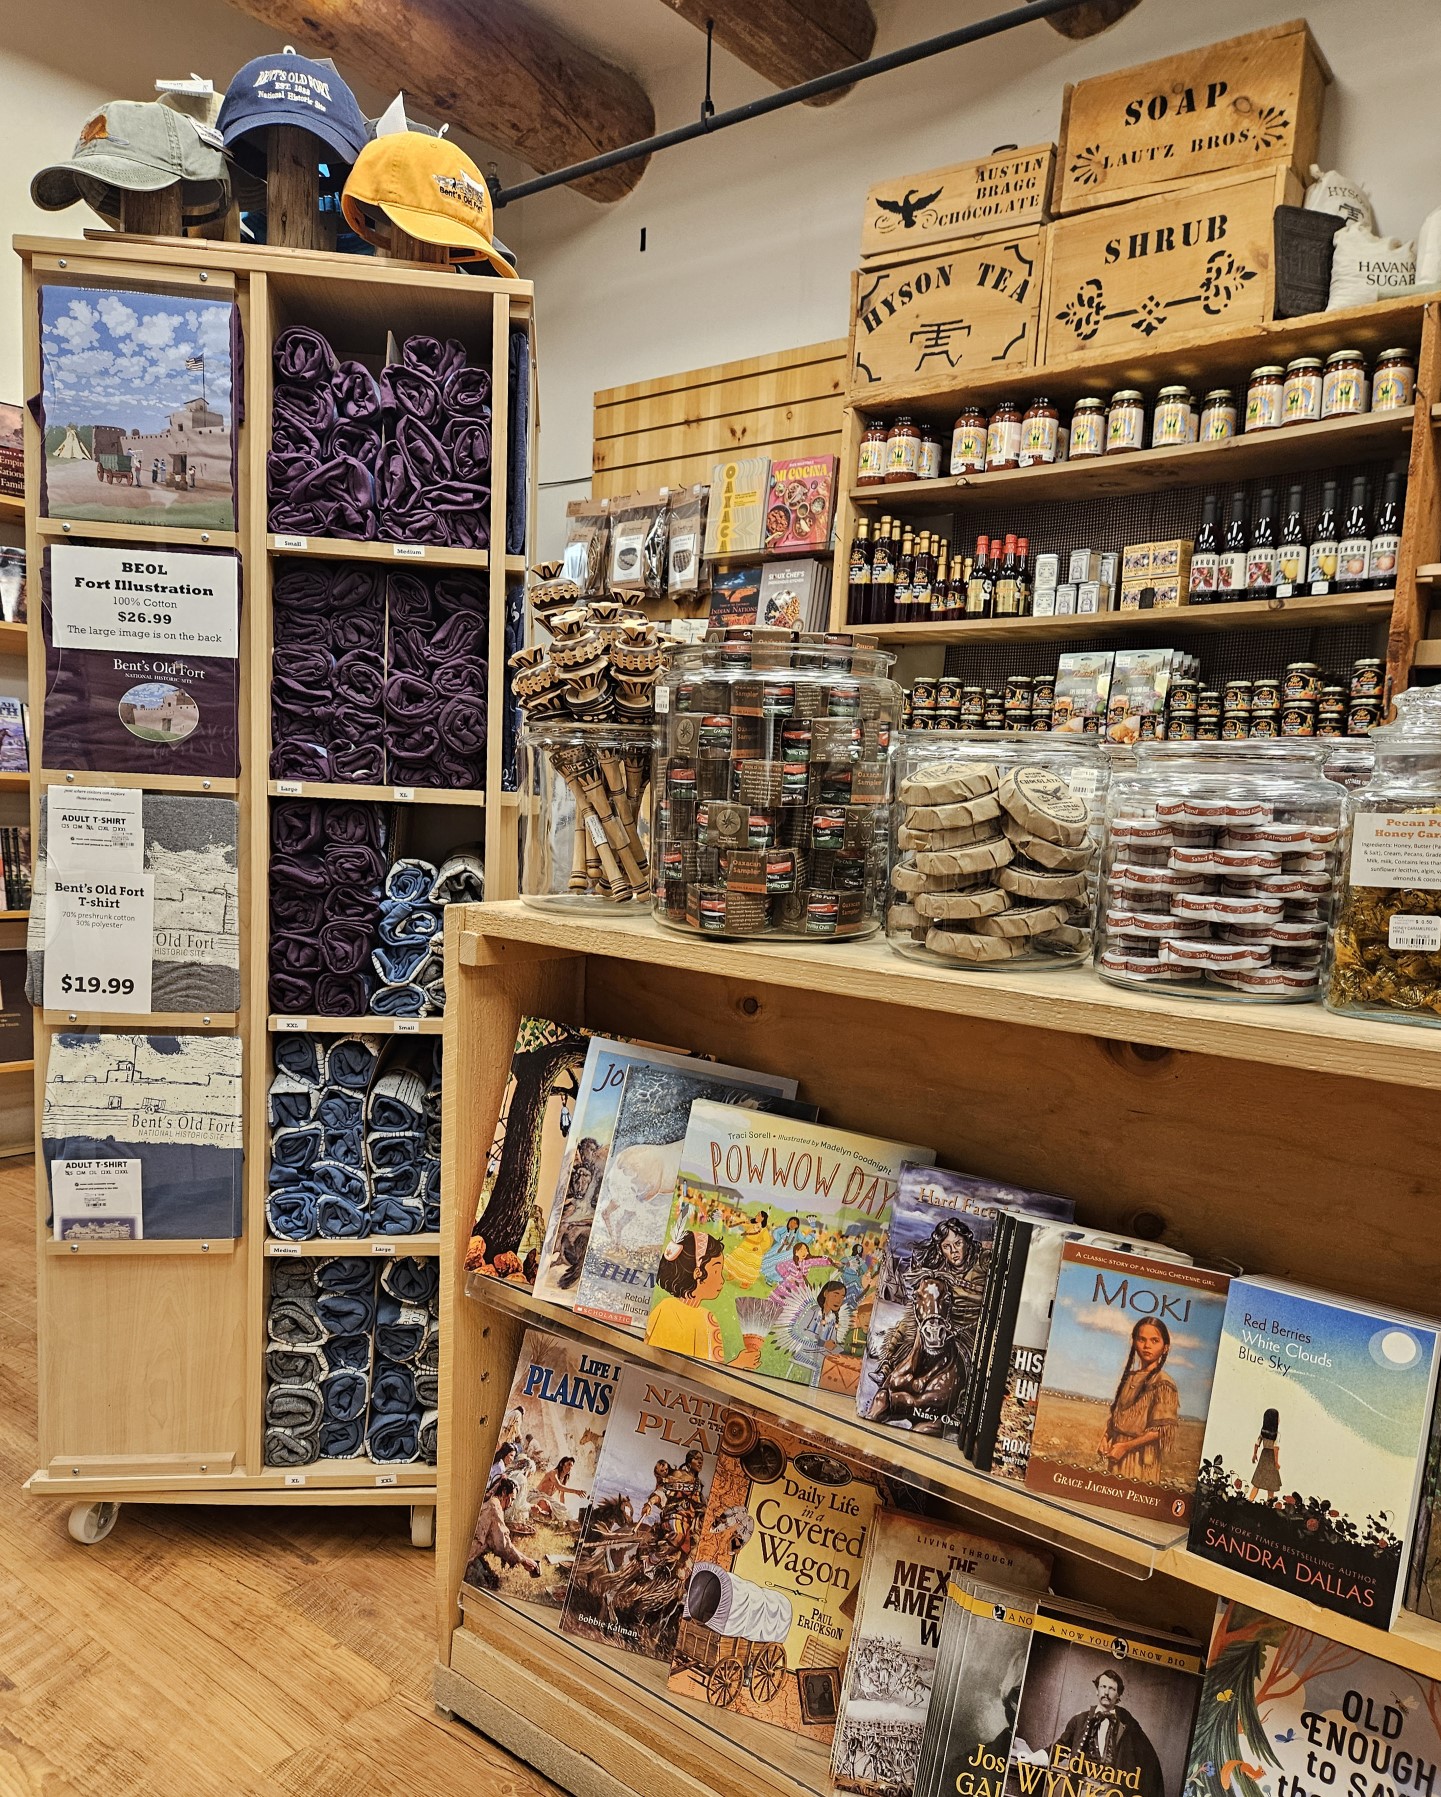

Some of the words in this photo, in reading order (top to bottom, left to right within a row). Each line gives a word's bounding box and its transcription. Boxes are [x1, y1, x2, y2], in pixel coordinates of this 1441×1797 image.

[288, 72, 308, 84] OLD
[258, 90, 285, 99] National
[1124, 81, 1228, 127] SOAP
[1101, 144, 1174, 170] LAUTZ
[1190, 128, 1256, 153] BROS.
[976, 156, 1044, 184] AUSTIN
[440, 186, 461, 200] Bent's
[976, 176, 1036, 200] BRAGG
[938, 194, 1040, 227] CHOCOLATE
[1104, 214, 1228, 265] SHRUB
[1359, 262, 1416, 273] HAVANA
[1366, 274, 1416, 286] SUGAR
[861, 264, 953, 335] HYSON
[976, 262, 1030, 304] TEA
[788, 464, 827, 480] COCINA
[122, 562, 168, 576] BEOL
[74, 577, 110, 590] Fort
[115, 580, 214, 596] Illustration
[113, 596, 140, 606] 100%
[144, 598, 178, 609] Cotton
[118, 611, 172, 625] $26.99
[67, 624, 86, 634] The
[89, 626, 116, 637] large
[119, 628, 150, 640] image
[153, 630, 161, 640] is
[179, 632, 195, 641] the
[198, 632, 222, 643] back
[113, 658, 149, 672] Bent's
[153, 661, 176, 674] Old
[180, 663, 205, 680] Fort
[1375, 830, 1414, 839] Honey
[732, 860, 761, 868] Oaxacan
[733, 867, 760, 876] Sampler
[55, 882, 92, 894] Bent's
[95, 885, 117, 896] Old
[120, 886, 144, 897] Fort
[78, 897, 120, 909] T-shirt
[62, 911, 76, 920] 70%
[78, 912, 112, 922] preshrunk
[114, 913, 135, 922] cotton
[91, 920, 123, 930] polyester
[155, 948, 188, 956] HISTORIC
[156, 932, 181, 947] Old
[188, 934, 215, 950] Fort
[61, 974, 134, 995] $19.99
[132, 1114, 172, 1128] Bent's
[178, 1116, 202, 1130] Old
[209, 1118, 235, 1134] Fort
[138, 1129, 173, 1138] NATIONAL
[175, 1131, 208, 1140] HISTORIC
[728, 1131, 747, 1140] Traci
[778, 1134, 811, 1145] Illustrated
[820, 1141, 852, 1157] Madelyn
[853, 1151, 892, 1176] Goodnight
[710, 1141, 841, 1197] POWWOW
[842, 1165, 898, 1220] DAY
[918, 1187, 958, 1210] Hard
[600, 1261, 640, 1286] THE
[1083, 1254, 1107, 1263] CLASSIC
[1109, 1259, 1128, 1268] STORY
[1146, 1267, 1167, 1276] YOUNG
[1169, 1271, 1201, 1283] CHEYENNE
[625, 1293, 650, 1304] Retold
[1092, 1273, 1192, 1322] MOKI
[583, 1308, 630, 1322] SCHOLASTIC
[1244, 1313, 1266, 1331] Red
[1272, 1320, 1311, 1344] Berries
[1241, 1330, 1280, 1352] White
[1286, 1342, 1332, 1368] Clouds
[579, 1354, 609, 1379] LIFE
[1238, 1346, 1264, 1366] Blue
[1268, 1354, 1291, 1376] Sky
[523, 1364, 612, 1415] PLAINS
[689, 1417, 705, 1426] OF
[912, 1406, 939, 1422] Nancy
[782, 1476, 825, 1506] Daily
[830, 1492, 860, 1517] Life
[1053, 1472, 1083, 1490] GRACE
[1085, 1478, 1124, 1498] JACKSON
[1126, 1489, 1161, 1507] PENNEY
[802, 1506, 814, 1517] in
[816, 1513, 824, 1522] a
[756, 1499, 867, 1559] Covered
[758, 1530, 851, 1590] Wagon
[917, 1536, 955, 1551] LIVING
[962, 1547, 1014, 1567] THROUGH
[1209, 1517, 1229, 1529] NEW
[1231, 1524, 1252, 1539] YORK
[1255, 1534, 1279, 1548] TIMES
[1282, 1543, 1334, 1570] BESTSELLING
[1338, 1566, 1377, 1585] AUTHOR
[947, 1555, 978, 1574] THE
[1205, 1529, 1286, 1574] SANDRA
[1296, 1563, 1375, 1607] DALLAS
[578, 1614, 606, 1630] Bobbie
[607, 1622, 638, 1638] Kalman
[797, 1614, 844, 1640] ERICKSON
[812, 1608, 833, 1627] PAUL
[1060, 1628, 1084, 1640] NOW
[1089, 1636, 1110, 1647] YOU
[1132, 1647, 1162, 1662] KNOW
[1168, 1657, 1185, 1667] BIO
[1342, 1690, 1404, 1740] OLD
[1300, 1712, 1437, 1797] ENOUGH
[1053, 1744, 1142, 1790] Edward
[1307, 1751, 1336, 1785] to
